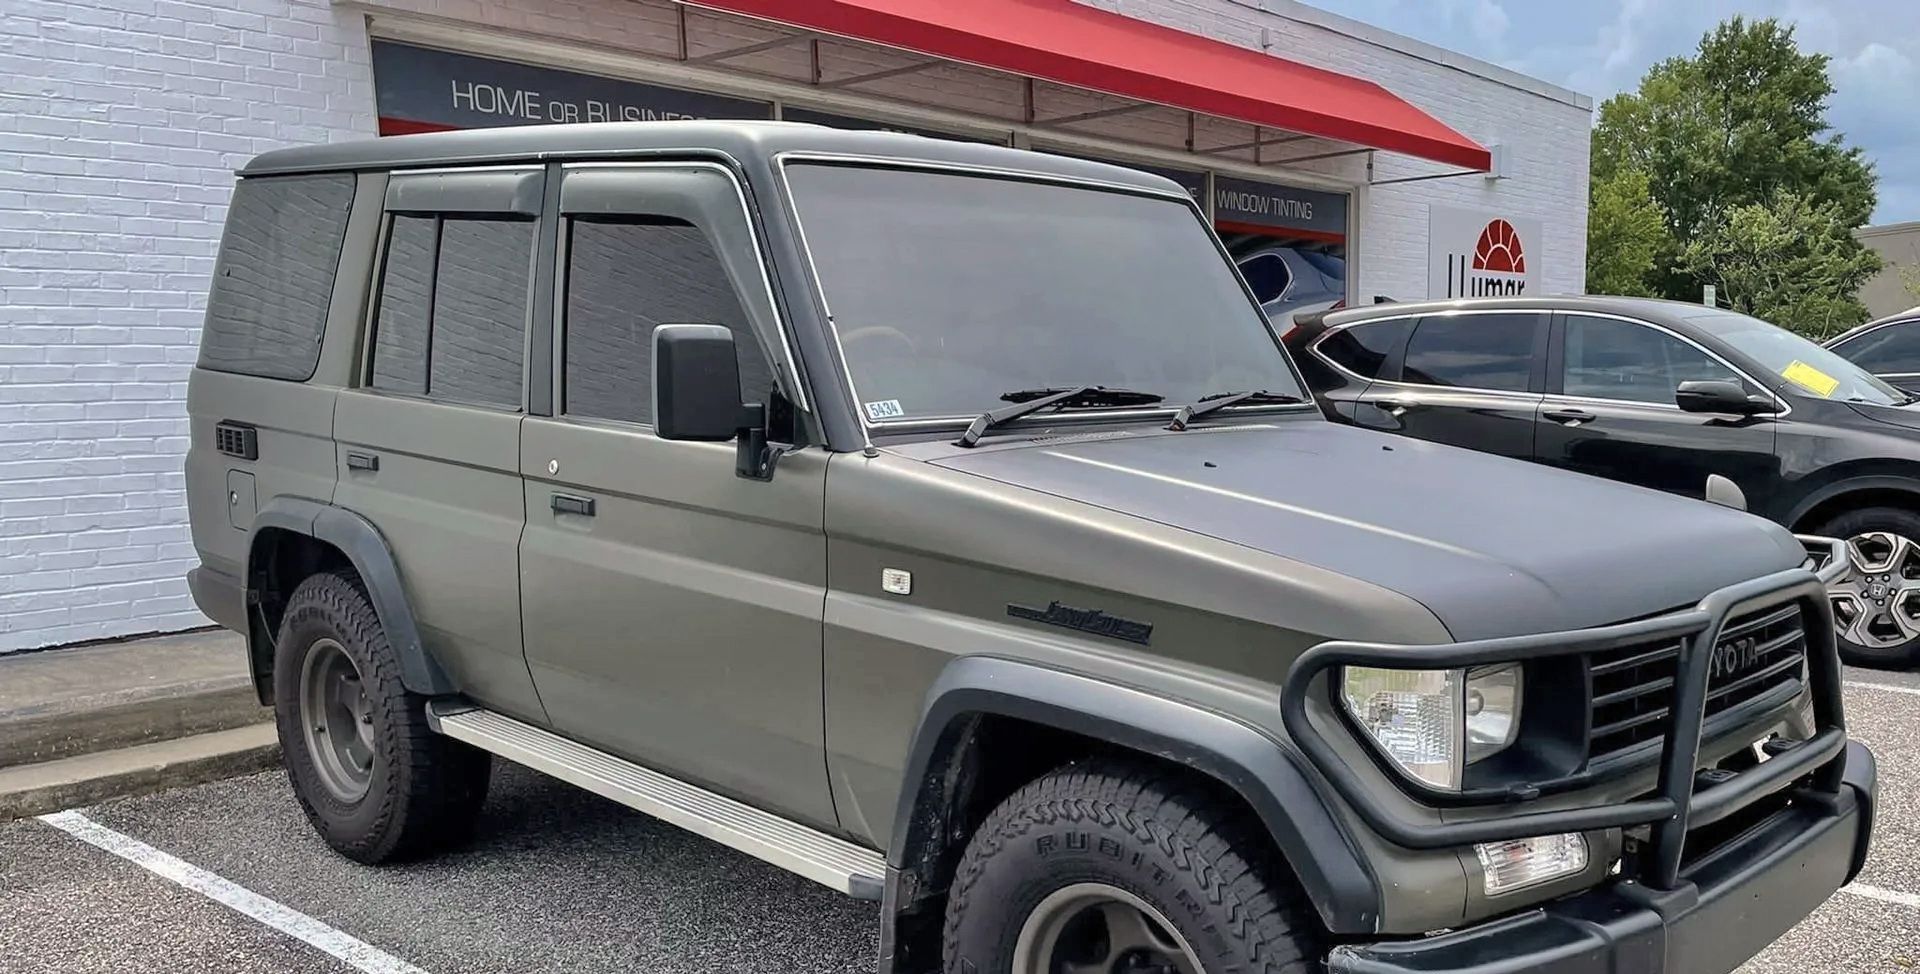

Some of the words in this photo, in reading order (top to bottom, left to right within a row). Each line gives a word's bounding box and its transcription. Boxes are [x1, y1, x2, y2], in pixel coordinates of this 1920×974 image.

[451, 80, 542, 120] HOME
[548, 101, 579, 123] OR
[1216, 189, 1270, 215] WINDOW
[1272, 197, 1313, 220] TINTING
[869, 402, 899, 417] 5434
[1713, 636, 1758, 678] YOTA
